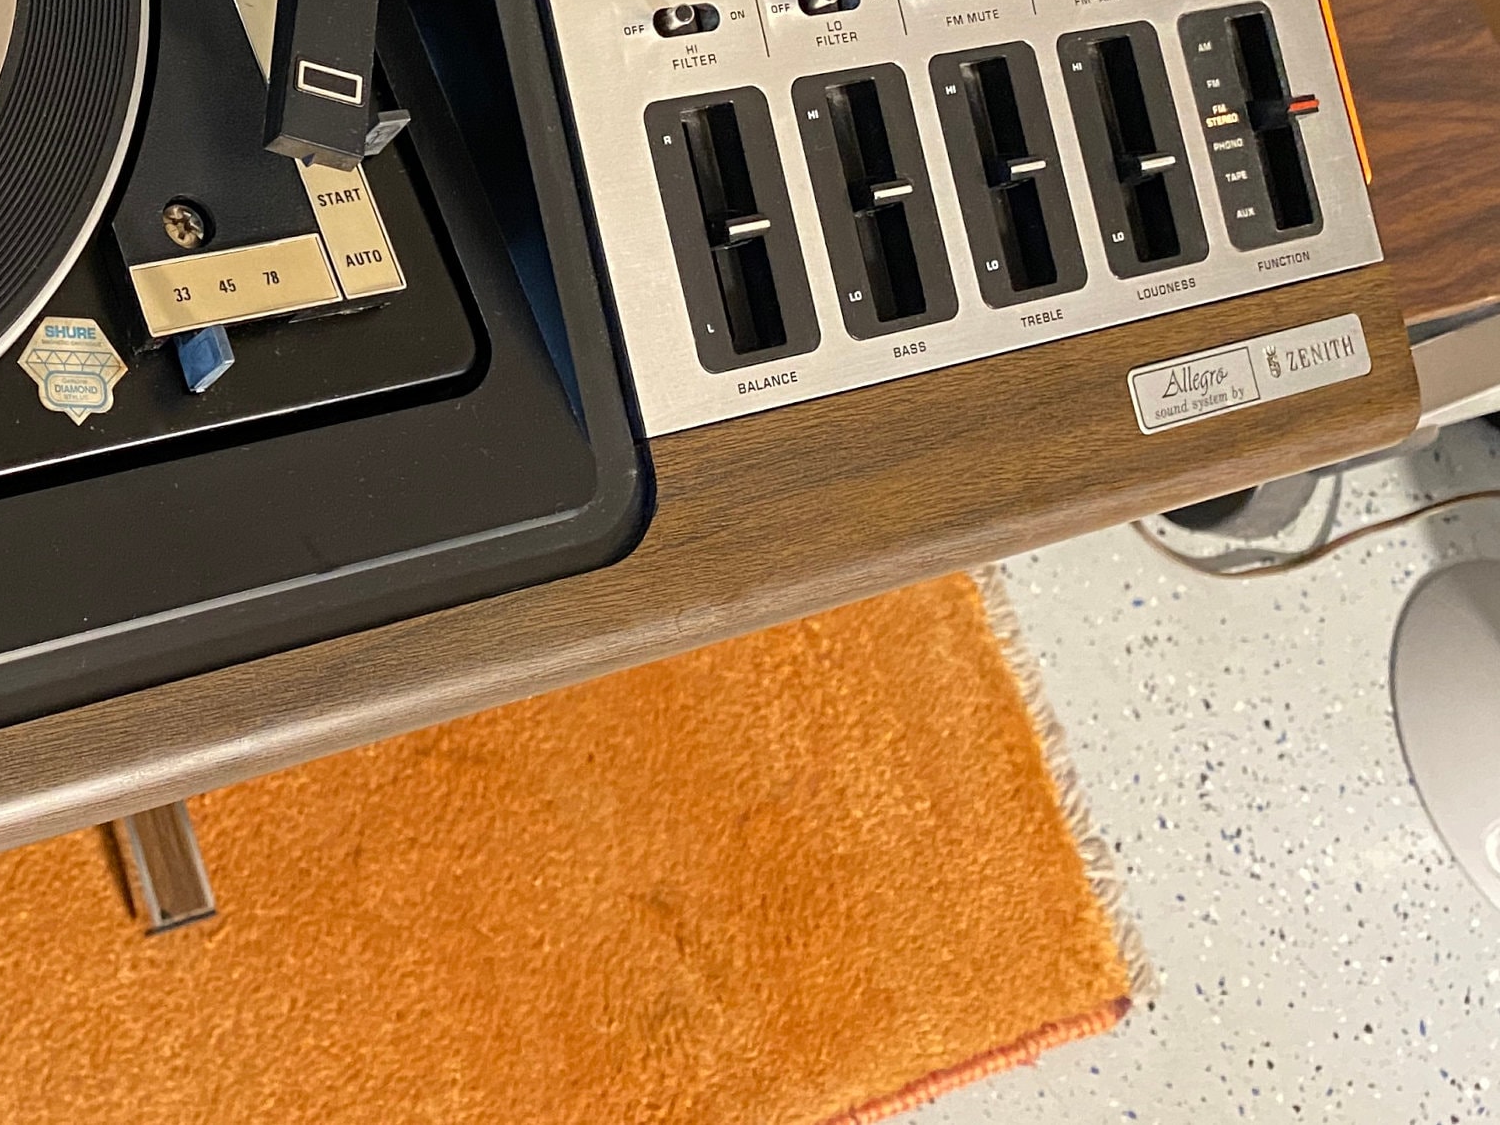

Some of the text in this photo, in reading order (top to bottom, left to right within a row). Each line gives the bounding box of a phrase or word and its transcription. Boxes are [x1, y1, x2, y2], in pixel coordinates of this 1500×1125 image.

[770, 2, 791, 15] OFF
[623, 9, 746, 36] OFF ON
[945, 8, 1000, 27] FM MUTE
[826, 20, 843, 32] LO
[815, 31, 859, 47] FILTER
[685, 43, 698, 55] HI
[1198, 41, 1212, 52] AM
[672, 53, 718, 70] FILTER
[1072, 62, 1083, 72] HI
[945, 84, 957, 95] HI
[1206, 78, 1221, 89] FM
[807, 109, 819, 120] HI
[1212, 103, 1228, 115] FM
[1206, 112, 1239, 128] STEREO
[663, 135, 672, 145] R
[1213, 137, 1244, 151] PHONO
[1225, 170, 1248, 183] TAPE
[317, 187, 362, 208] START
[1236, 207, 1255, 220] AUX
[1112, 231, 1125, 243] LO
[345, 249, 383, 268] AUTO
[986, 259, 999, 271] LO
[1257, 250, 1311, 272] FUNCTION
[173, 270, 280, 303] 33 45 78
[1137, 277, 1197, 301] LOUDNESS
[849, 290, 863, 302] LO
[1020, 308, 1064, 329] TREBLE
[44, 324, 97, 340] SHURE
[706, 324, 715, 334] L
[893, 340, 927, 359] BASS
[1285, 334, 1356, 373] ZENITH
[737, 370, 799, 395] BALANCE
[1161, 365, 1229, 399] Allegro
[54, 384, 98, 395] DIAMOND
[1155, 386, 1246, 420] sound system by
